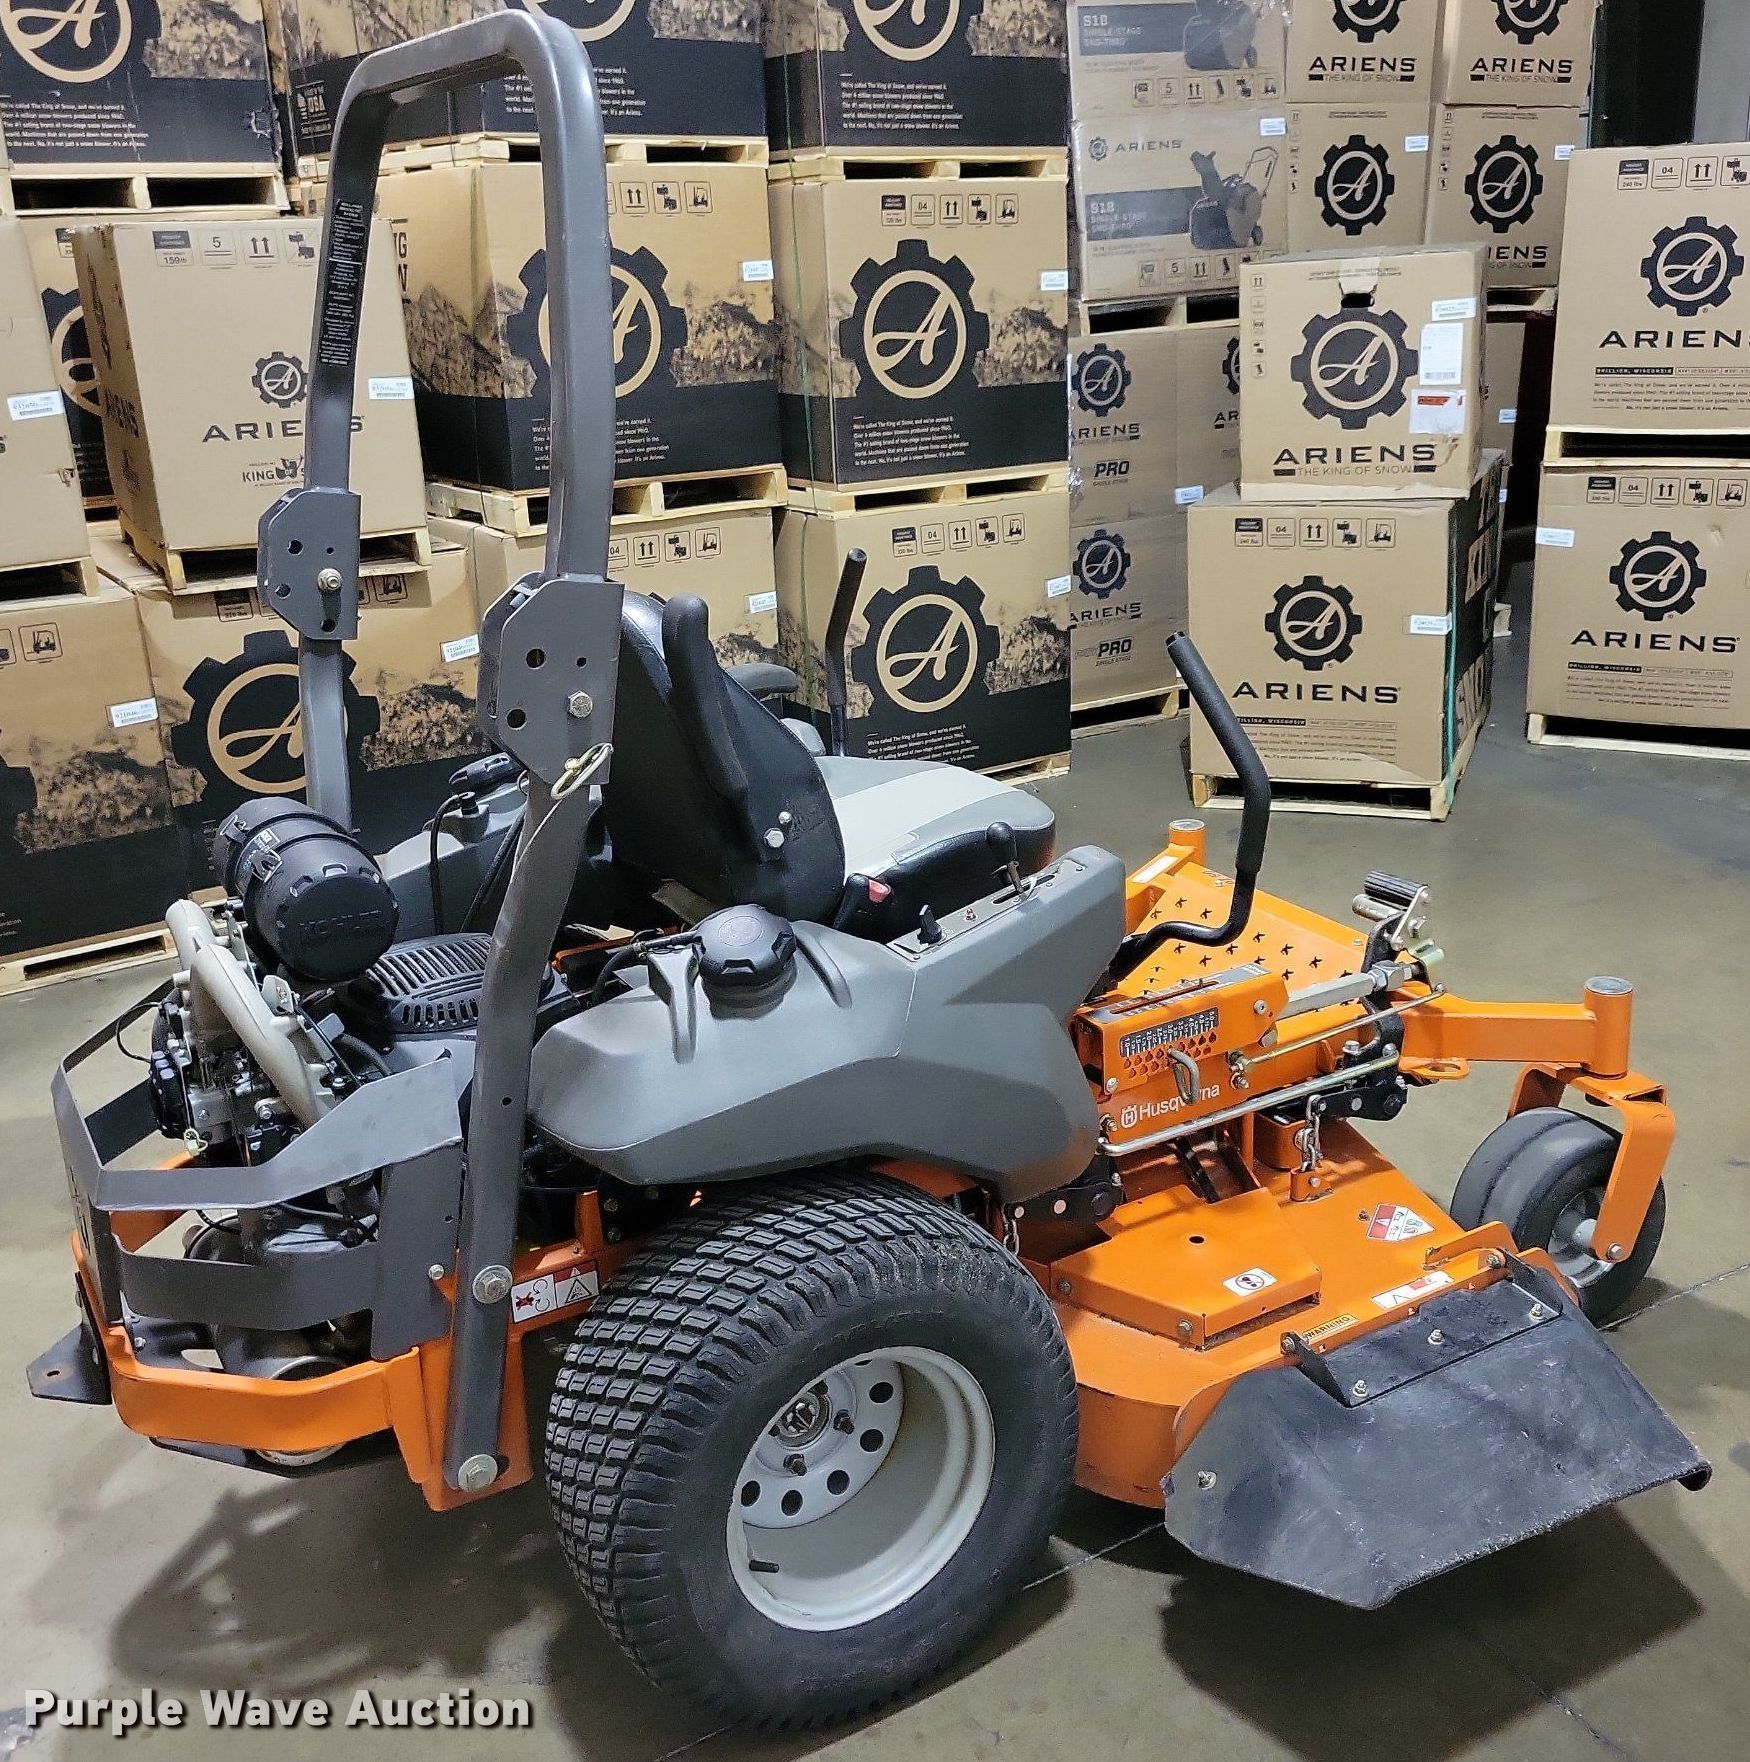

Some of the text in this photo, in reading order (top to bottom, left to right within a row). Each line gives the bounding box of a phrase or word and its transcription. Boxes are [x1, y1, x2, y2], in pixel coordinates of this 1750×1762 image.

[1309, 57, 1416, 72] ARIENS
[1470, 58, 1573, 73] ARIENS
[1166, 83, 1173, 93] 5
[1116, 139, 1184, 153] ARIENS
[1661, 166, 1673, 174] 04
[918, 201, 928, 211] 04
[212, 236, 221, 248] 5
[1488, 246, 1548, 259] IENS
[164, 256, 180, 265] 159
[1171, 263, 1179, 273] 5
[1599, 330, 1750, 349] ARIEN
[202, 416, 363, 443] ARIES
[1273, 444, 1437, 465] ARIENS
[1094, 460, 1130, 478] PRO
[1299, 464, 1413, 477] THE KING OF SNOW
[242, 470, 274, 483] KING
[927, 531, 937, 539] 04
[1276, 525, 1287, 533] 04
[610, 545, 620, 555] 04
[1098, 639, 1132, 657] PRO
[1570, 630, 1738, 654] ARIENS
[1232, 682, 1399, 704] ARIENS
[1139, 1084, 1220, 1121] Husqvna
[1307, 1316, 1350, 1338] WARNING
